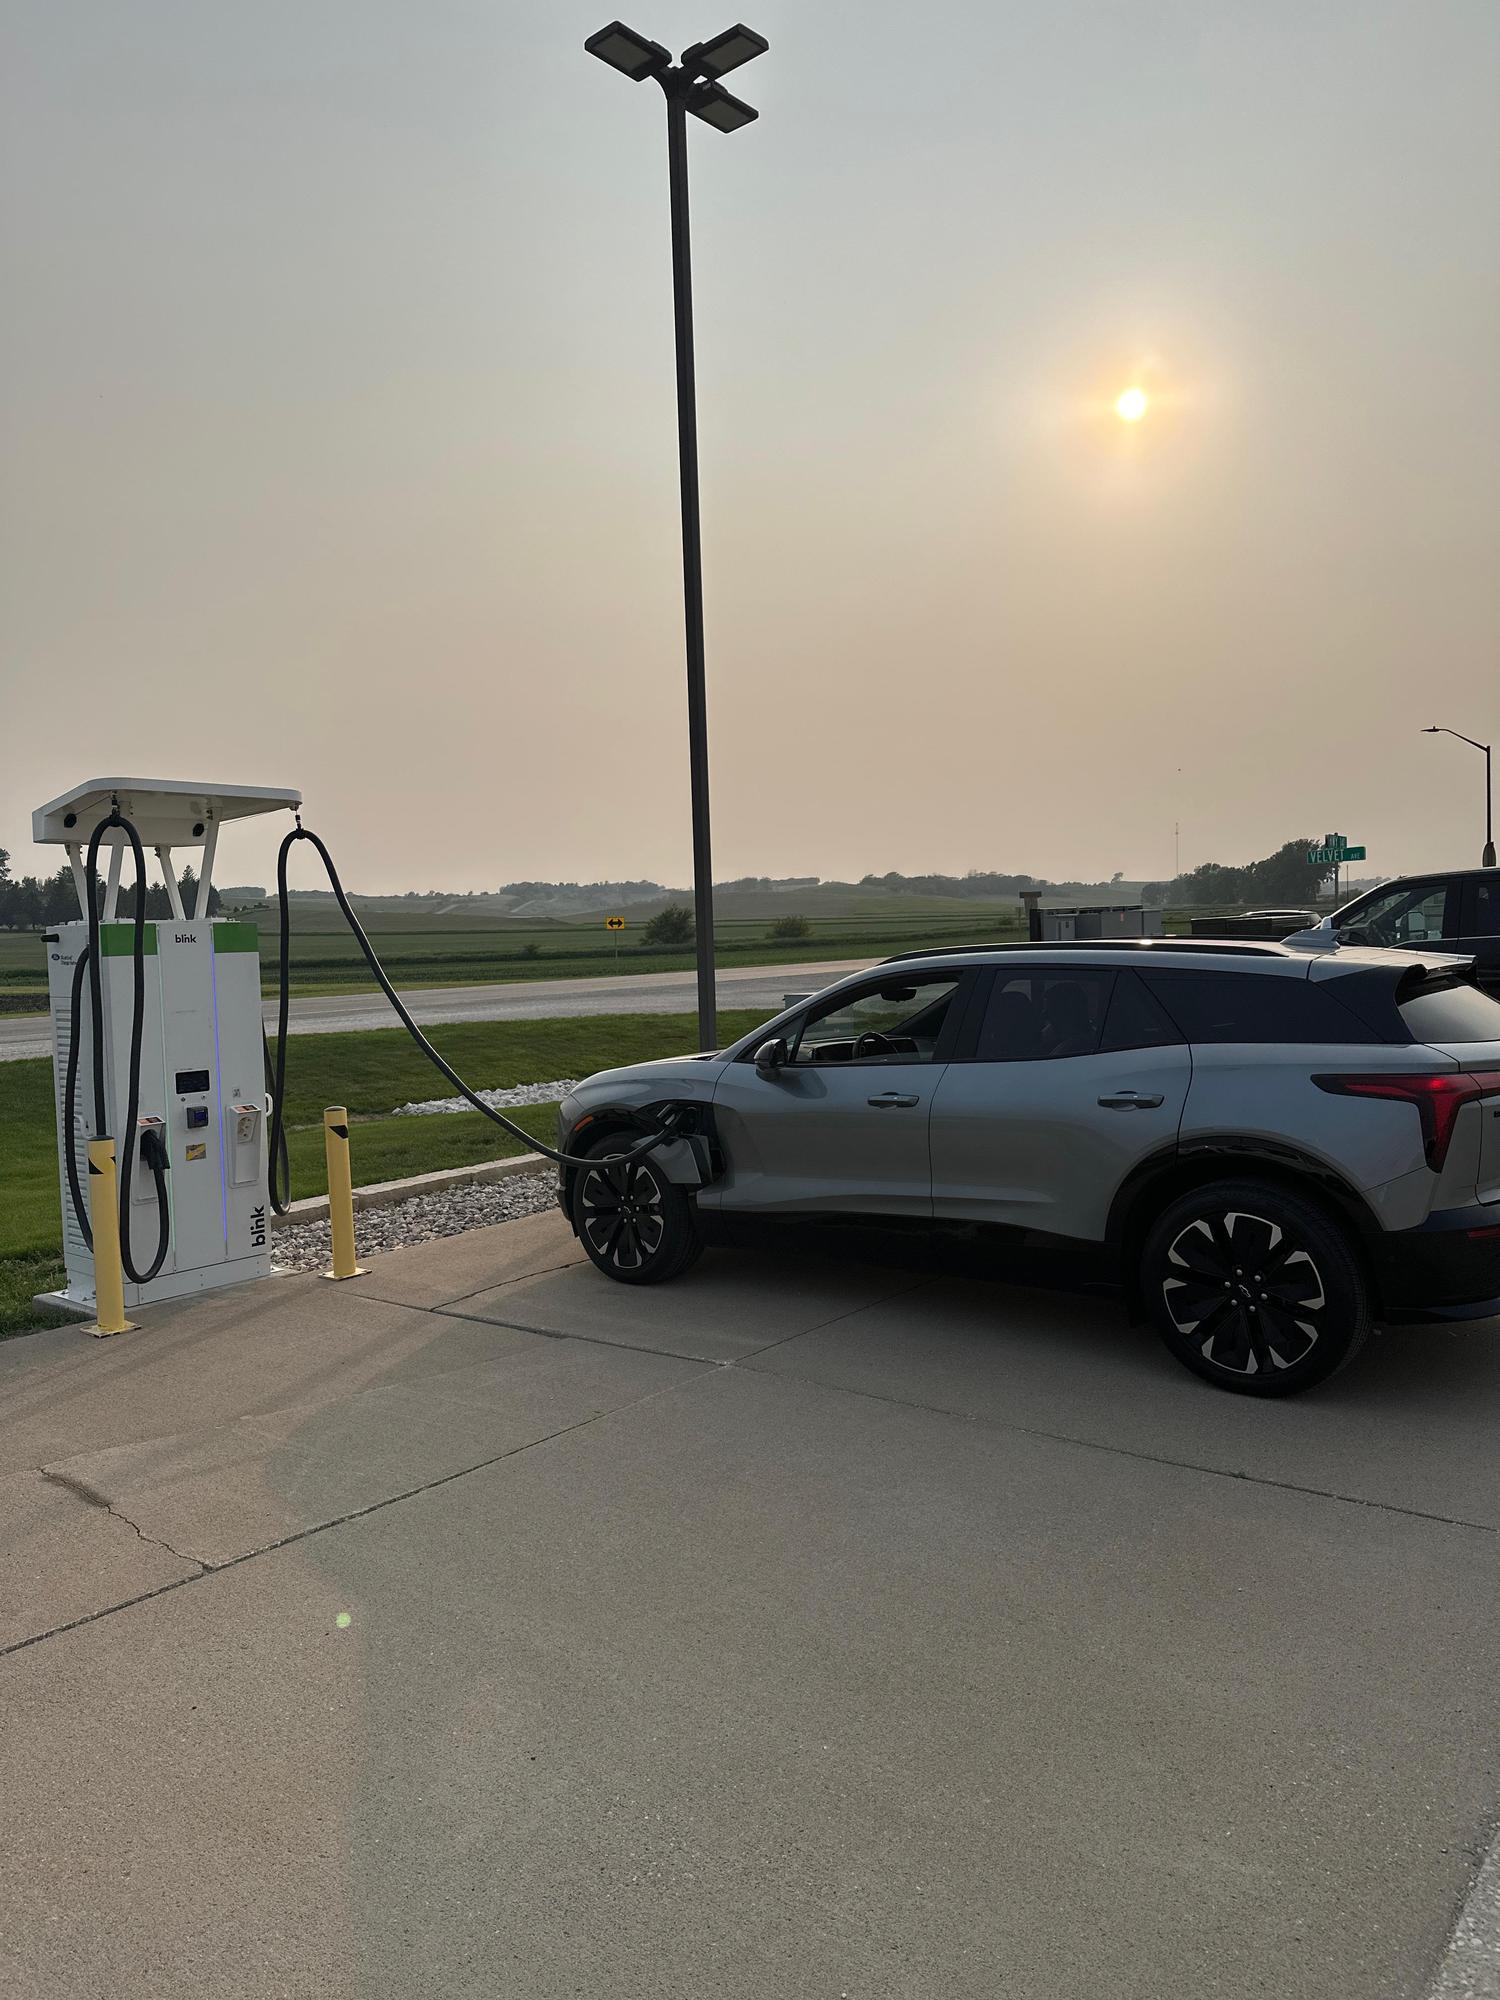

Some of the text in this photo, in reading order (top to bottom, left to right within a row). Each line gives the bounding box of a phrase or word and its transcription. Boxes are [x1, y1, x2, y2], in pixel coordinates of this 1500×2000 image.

[1310, 849, 1344, 863] VELVET
[175, 934, 197, 944] blink
[250, 1204, 266, 1248] blink
